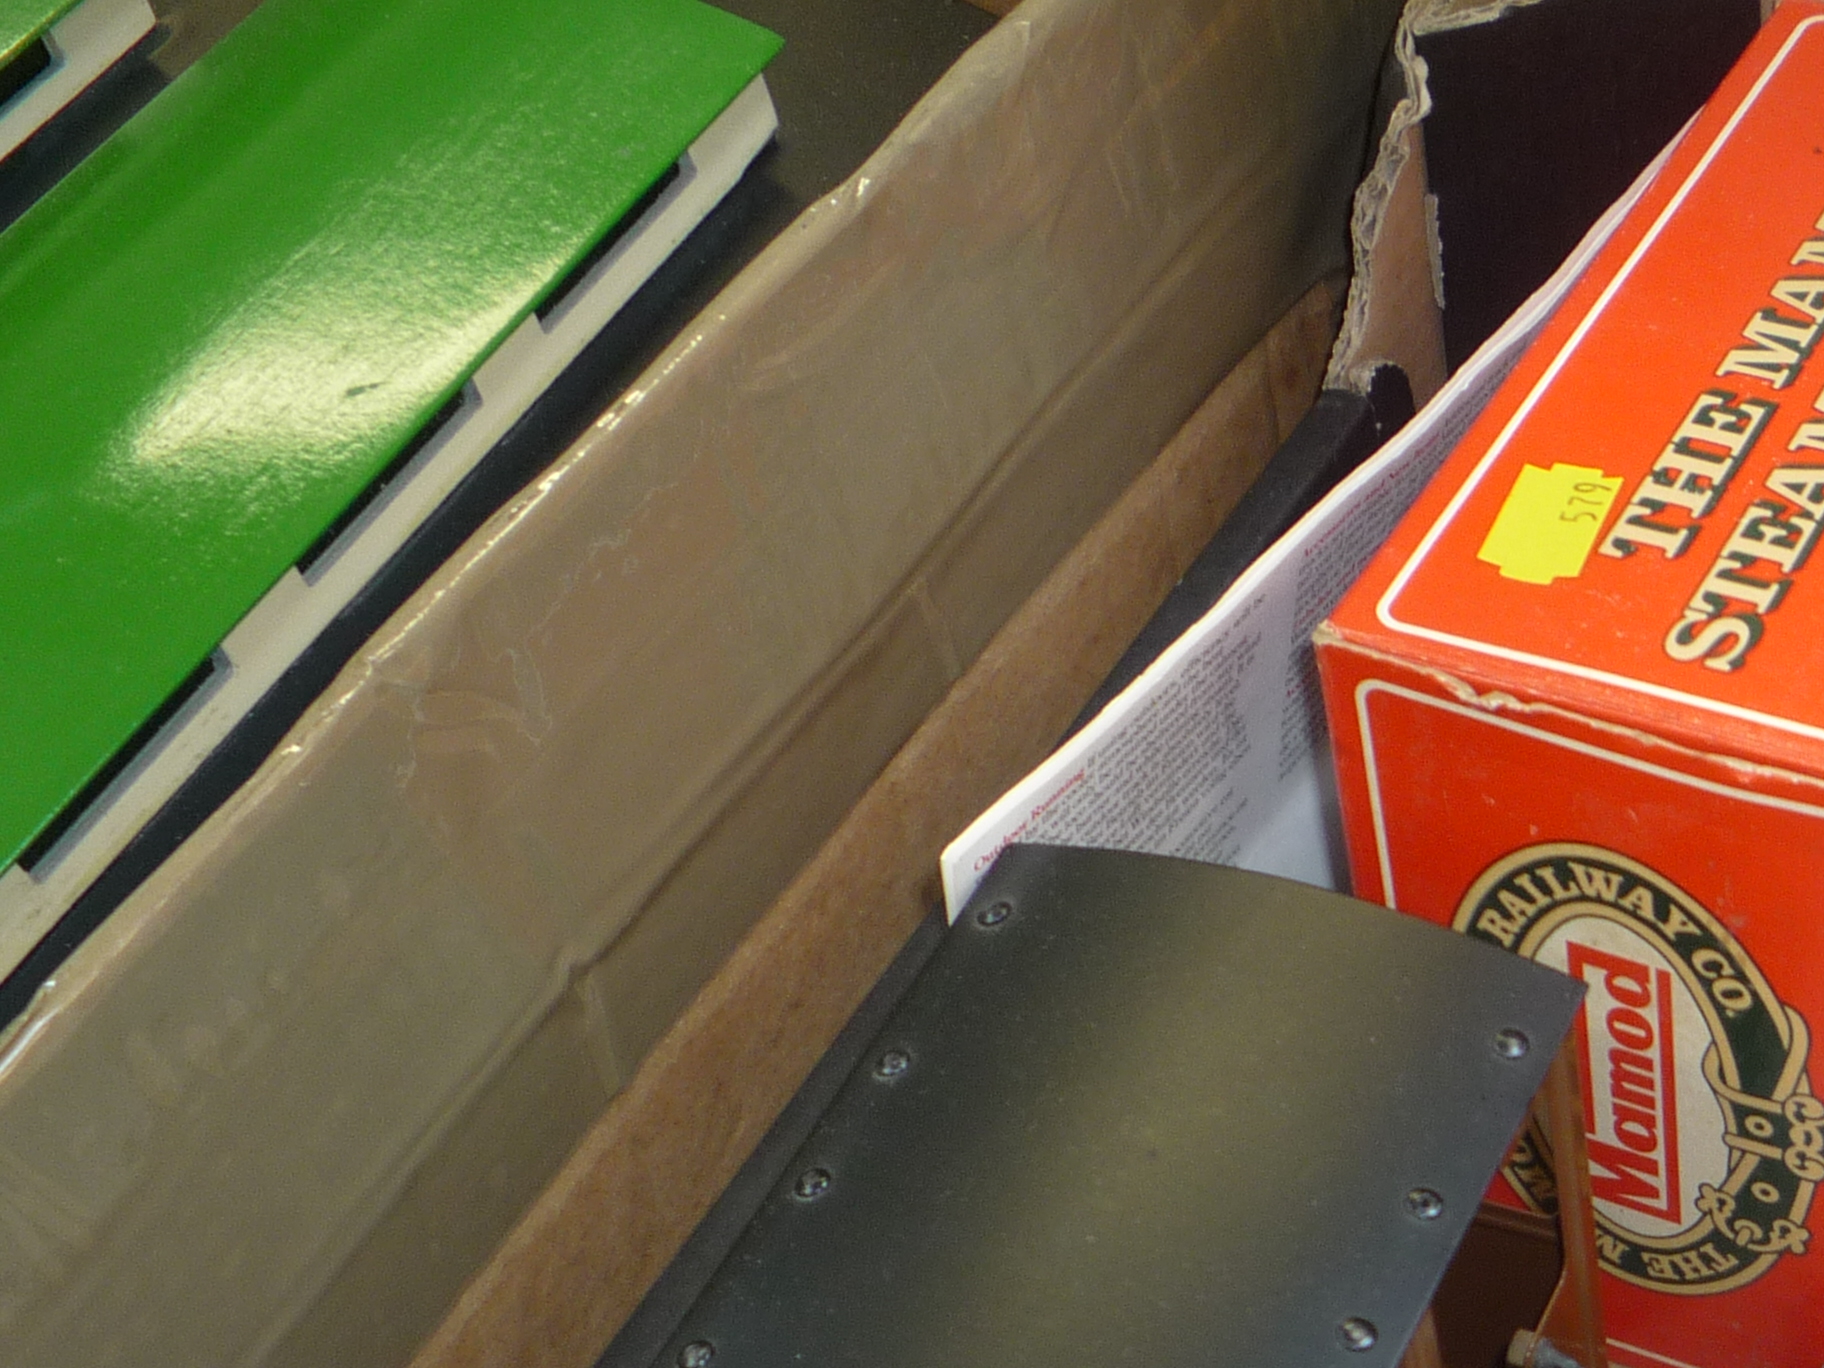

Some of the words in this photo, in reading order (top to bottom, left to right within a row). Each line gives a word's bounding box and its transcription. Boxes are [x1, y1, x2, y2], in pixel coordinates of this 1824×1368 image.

[1558, 482, 1612, 522] 579
[1599, 392, 1778, 559] THE
[1477, 861, 1702, 948] RAILWAY
[1691, 948, 1752, 1018] CO.
[1586, 953, 1661, 1200] Mamod
[1641, 1243, 1739, 1280] THE
